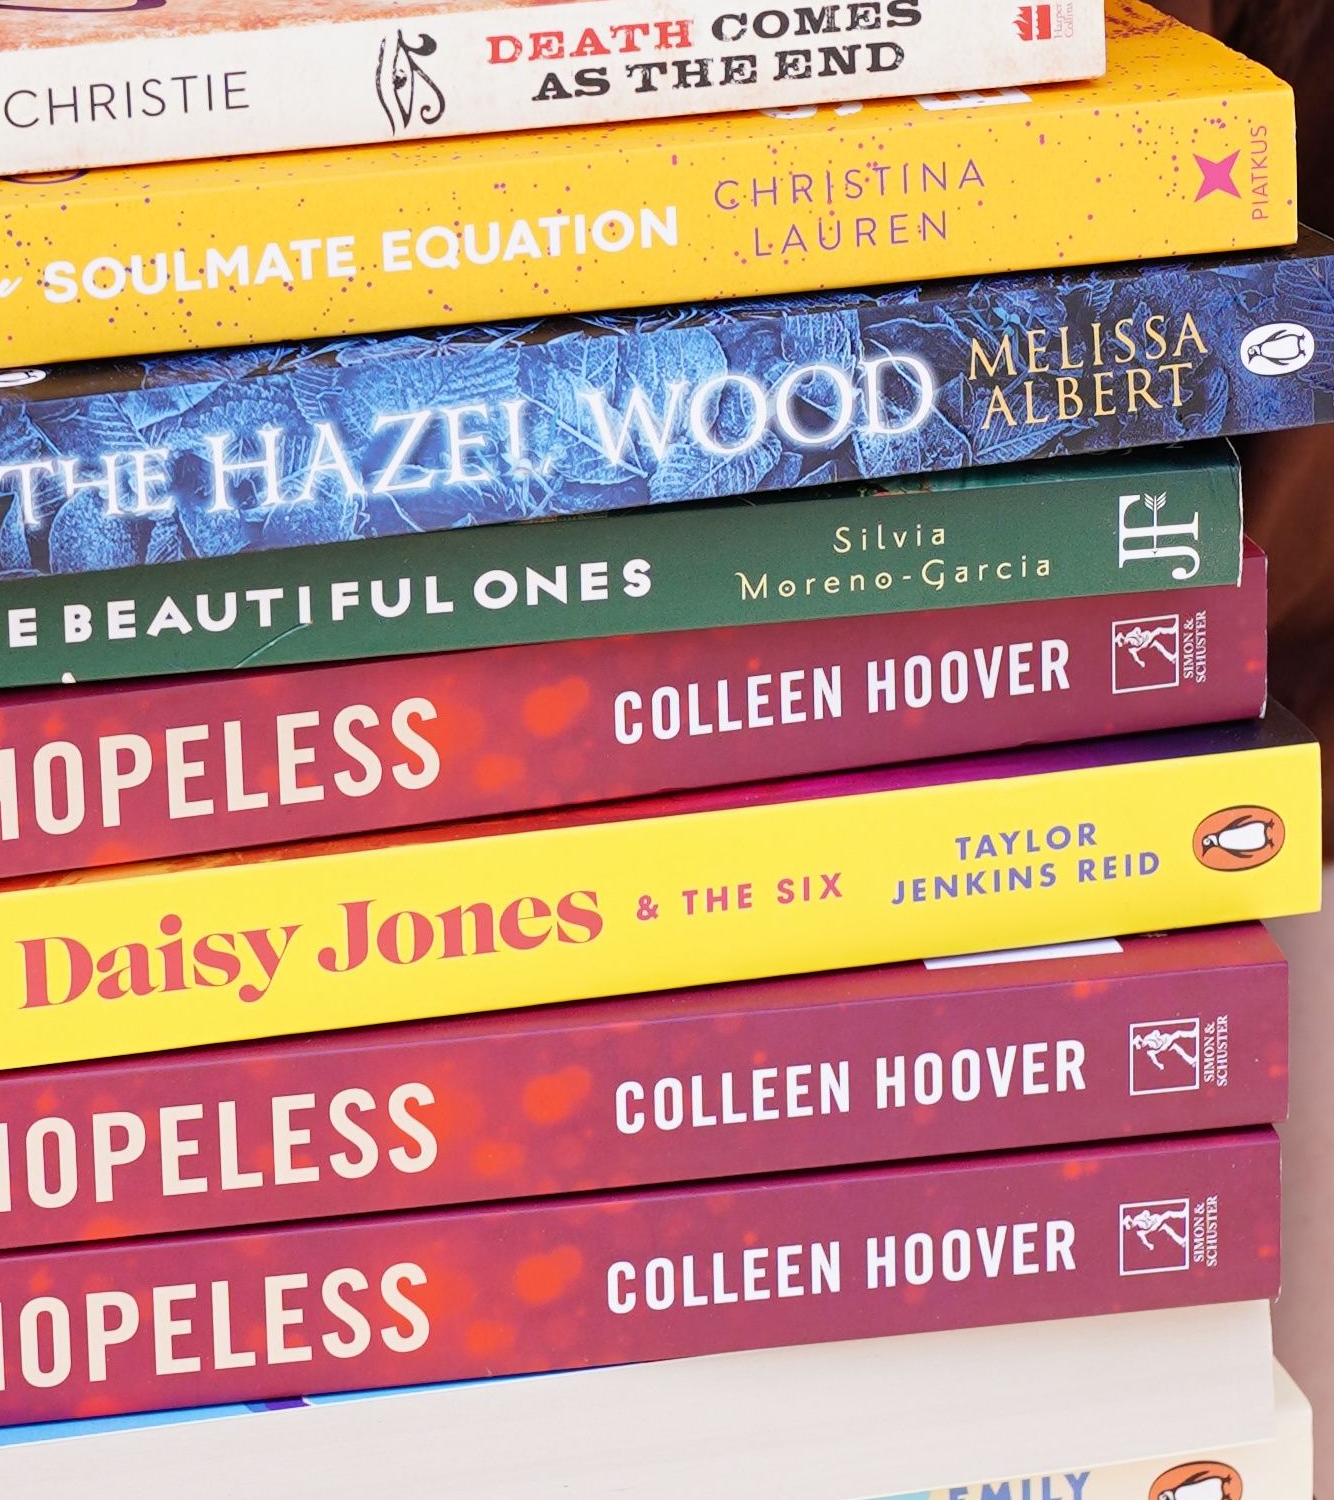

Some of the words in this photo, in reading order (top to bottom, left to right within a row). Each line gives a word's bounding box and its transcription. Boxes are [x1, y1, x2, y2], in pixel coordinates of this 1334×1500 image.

[486, 20, 694, 64] DEATH
[531, 66, 610, 101] AS
[626, 55, 758, 92] THE
[773, 41, 905, 82] END
[3, 70, 250, 129] CHRISTIE
[715, 159, 986, 212] CHRISTINA
[1251, 123, 1268, 221] PIATKUS
[42, 236, 356, 304] SOULMATE
[383, 205, 679, 272] EQUATION
[754, 210, 948, 256] LAUREN
[968, 312, 1207, 380] MELISSA
[981, 362, 1193, 430] ALBERT
[205, 402, 557, 513] HAZEL
[578, 354, 935, 469] WOOD
[833, 521, 946, 554] Silvia
[64, 575, 454, 644] BEAUTIFUL
[473, 558, 653, 606] ONES
[735, 556, 1052, 602] Moreno-Garcia
[1183, 617, 1194, 630] &
[1195, 610, 1207, 683] SCHUSTER
[1183, 632, 1194, 679] SIMON
[613, 664, 843, 745] COLLEEN
[867, 637, 1071, 714] HOOVER
[954, 822, 1099, 862] TAYLOR
[890, 863, 1057, 906] JENKINS
[1078, 850, 1161, 883] REID
[16, 913, 303, 1010] Daisy
[318, 890, 604, 975] Jones
[636, 895, 660, 922] &
[682, 882, 754, 917] THE
[777, 871, 844, 903] SIX
[1203, 1022, 1215, 1035] &
[1216, 1014, 1228, 1087] SCHUSTER
[614, 1060, 851, 1135] COLLEEN
[876, 1039, 1087, 1110] HOOVER
[1203, 1036, 1215, 1083] SIMON
[1193, 1202, 1205, 1215] &
[1206, 1195, 1218, 1268] SCHUSTER
[605, 1240, 842, 1315] COLLEEN
[866, 1219, 1077, 1289] HOOVER
[1193, 1216, 1205, 1263] SIMON
